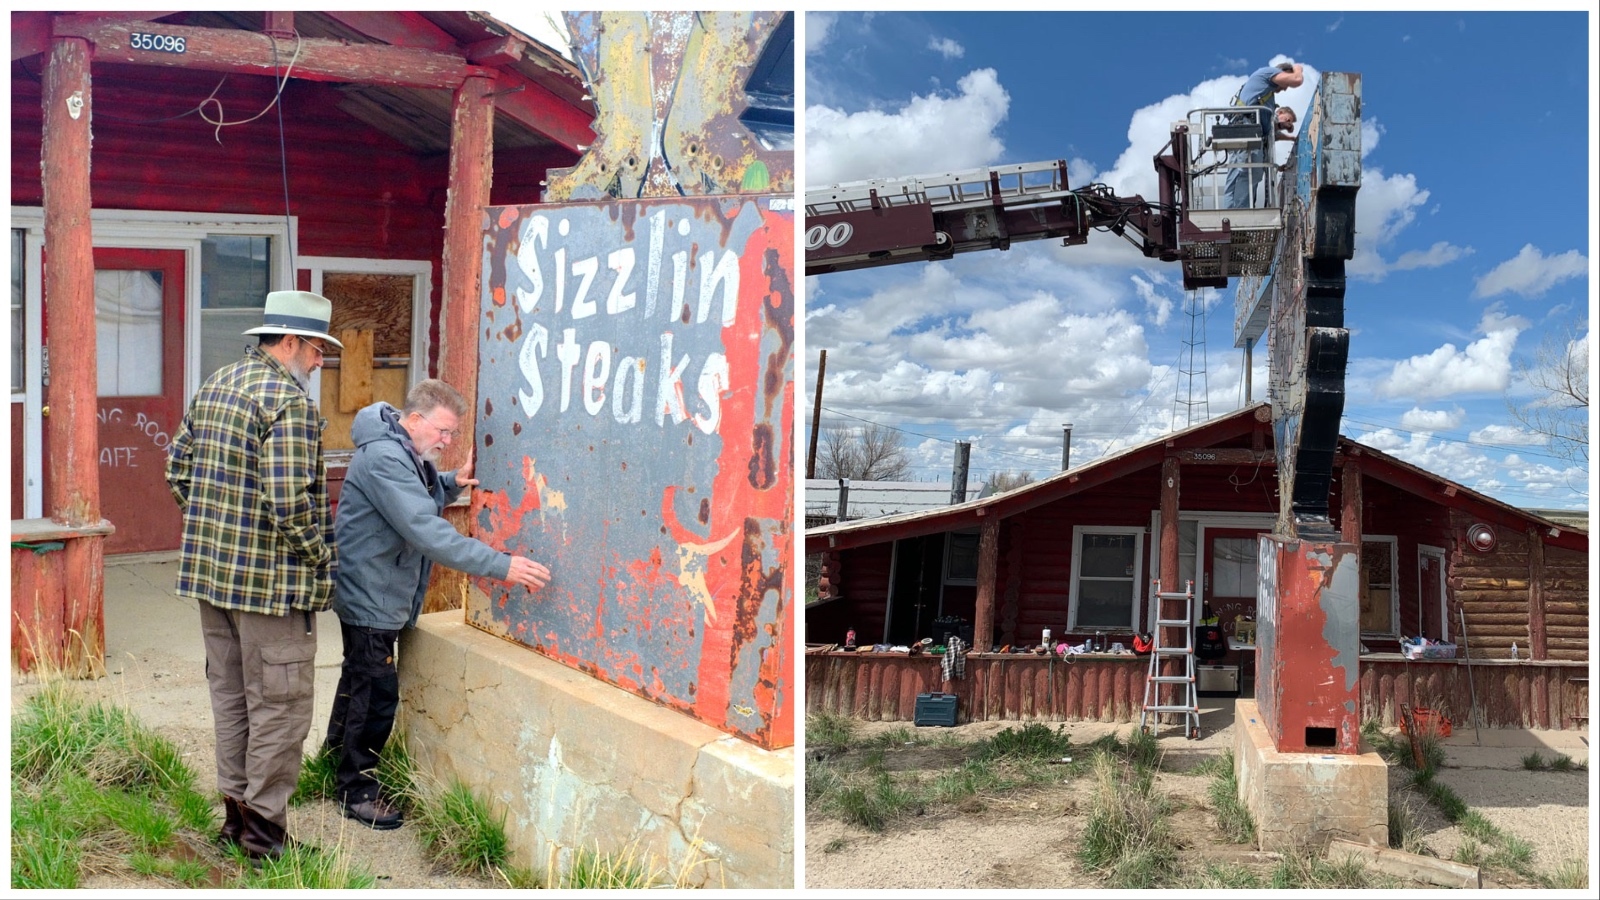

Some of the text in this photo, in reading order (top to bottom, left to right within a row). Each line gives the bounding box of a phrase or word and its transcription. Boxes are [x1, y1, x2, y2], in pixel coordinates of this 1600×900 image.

[130, 33, 185, 53] 35096
[516, 209, 740, 327] Sizzlin
[517, 322, 729, 435] Steaks
